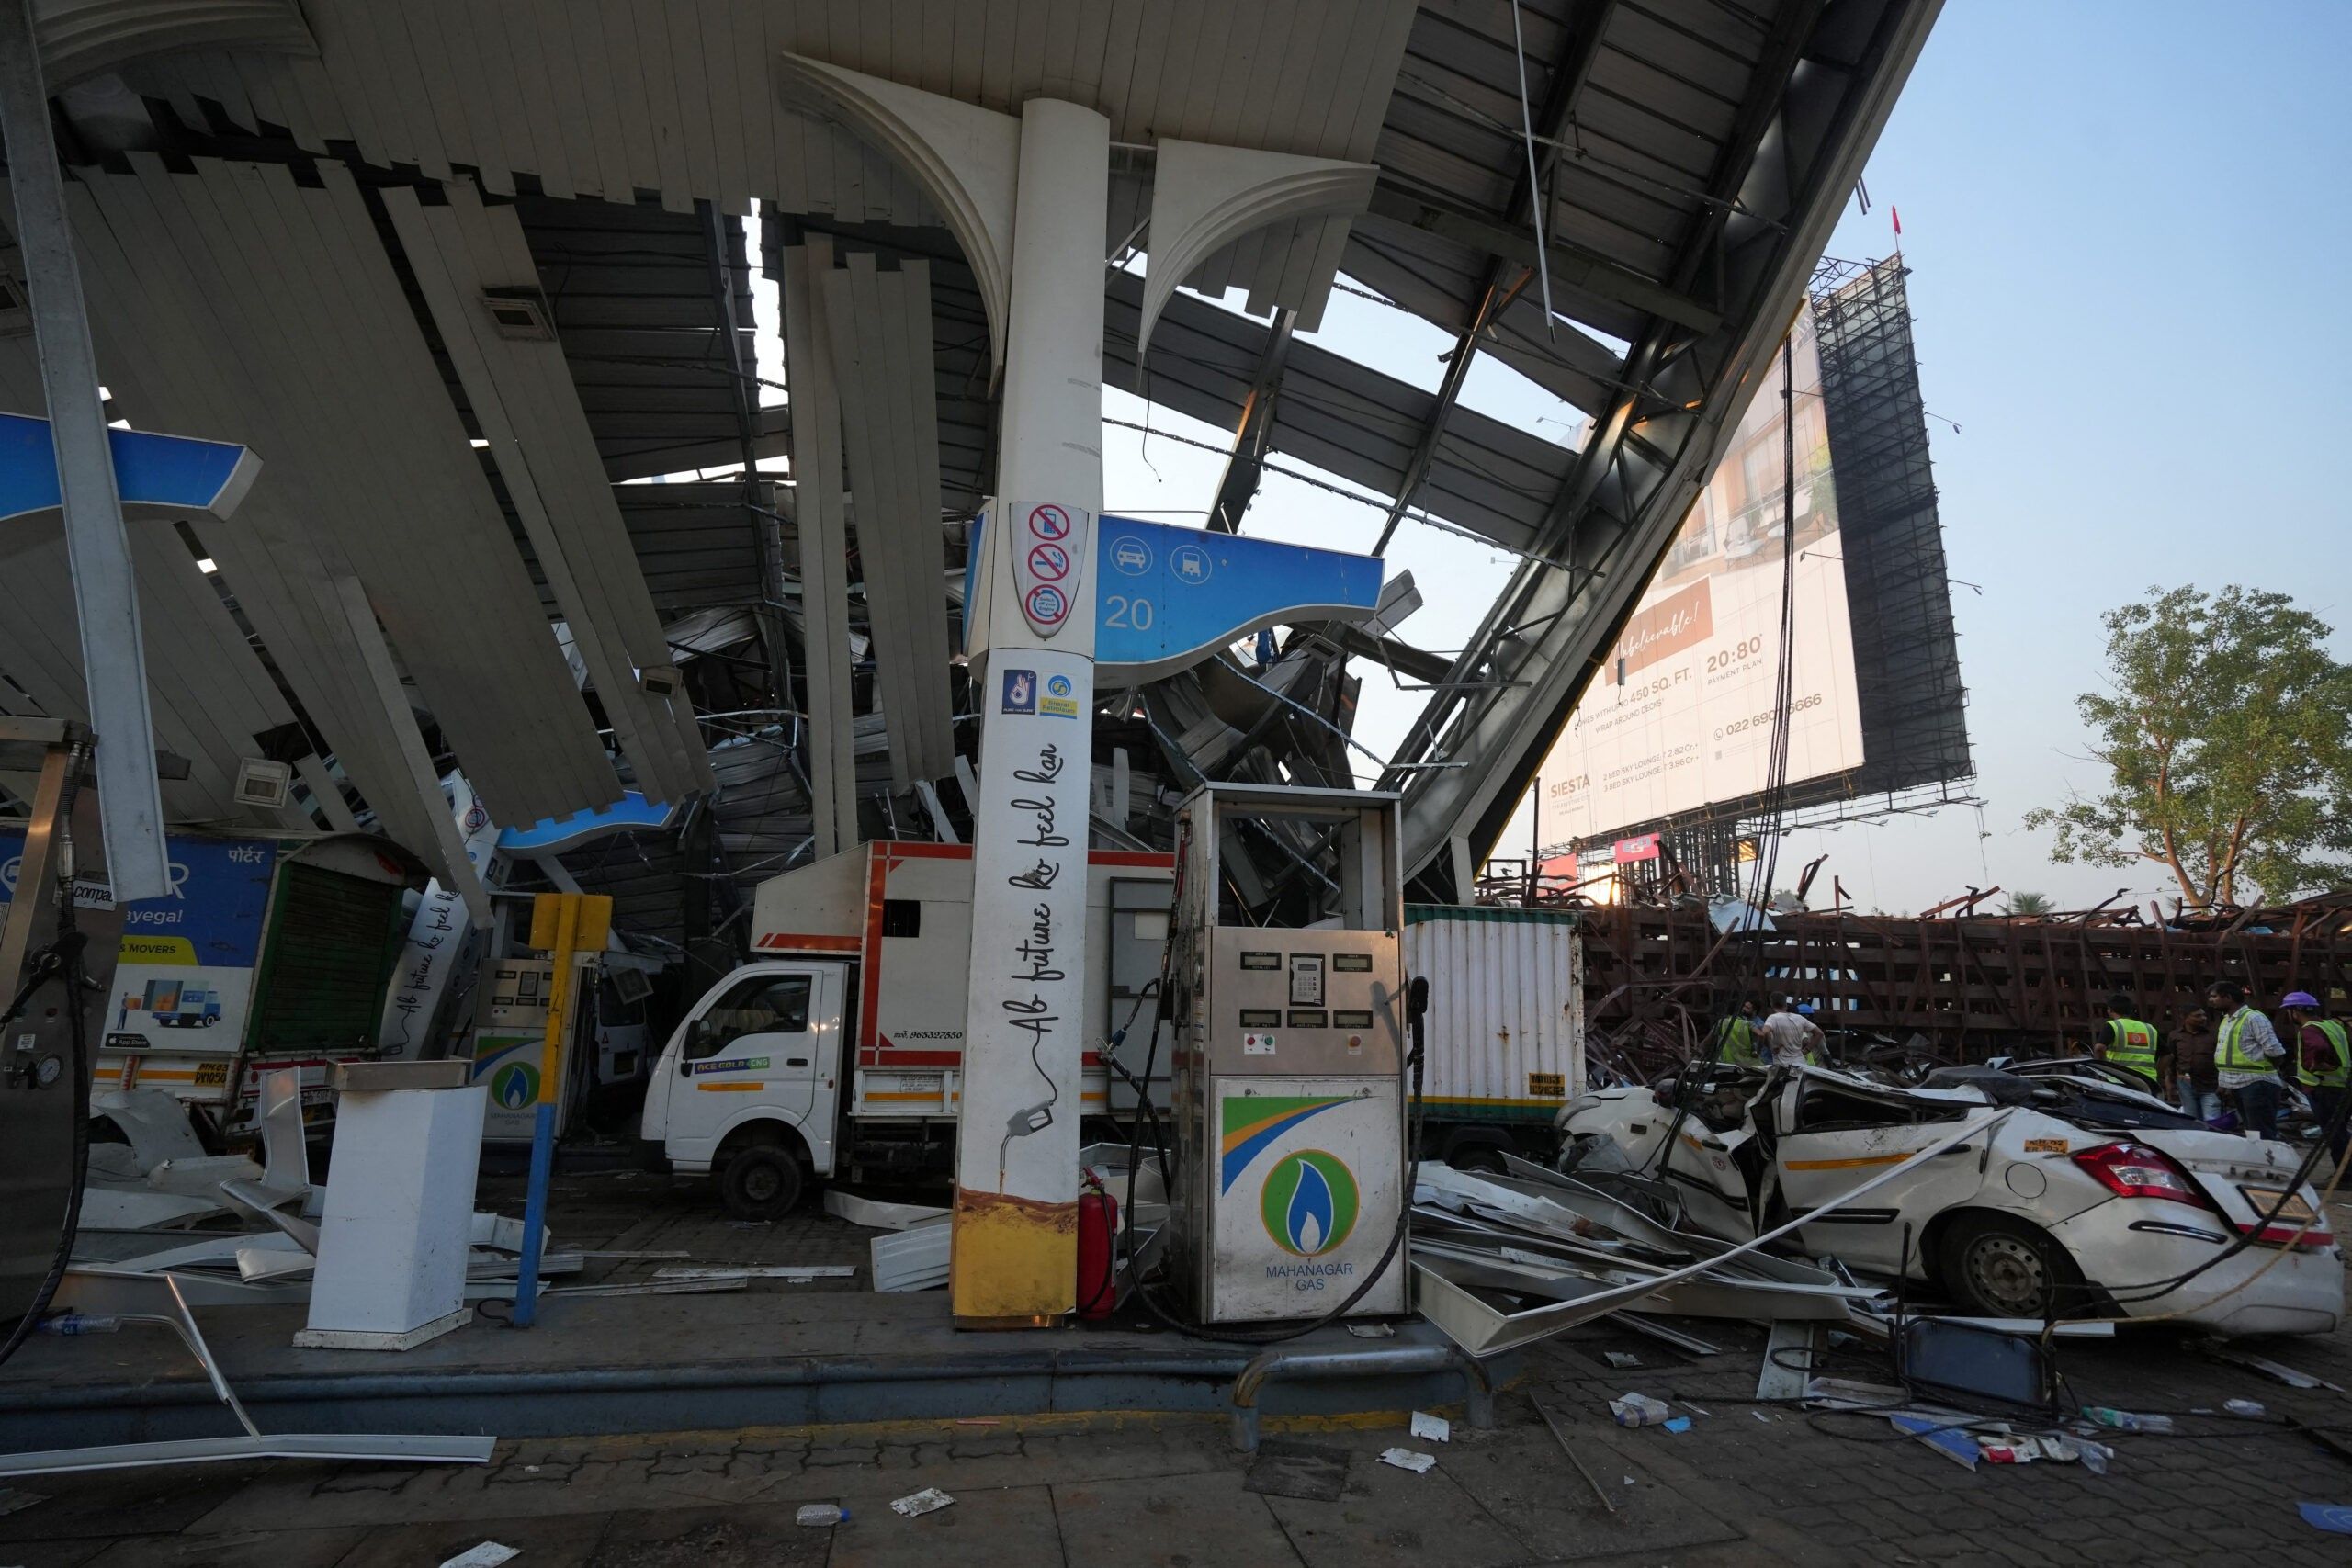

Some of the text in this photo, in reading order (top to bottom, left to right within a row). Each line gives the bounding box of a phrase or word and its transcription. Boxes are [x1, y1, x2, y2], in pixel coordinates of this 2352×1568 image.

[1105, 594, 1153, 631] 20
[1707, 659, 1763, 685] PAYMENT PLAN
[1630, 686, 1650, 704] 450
[1652, 678, 1672, 694] SQ.
[1675, 668, 1692, 685] FT.
[1595, 720, 1613, 734] WRAP
[1614, 709, 1640, 727] AROUND
[1726, 719, 1749, 735] 022
[1013, 743, 1064, 784] kar
[1551, 773, 1590, 798] SIESTA
[1011, 796, 1069, 846] feel
[228, 846, 266, 867] पोर्टर
[129, 944, 176, 954] MOVERS
[1012, 903, 1066, 981] future
[751, 1058, 768, 1066] CNG
[1266, 1263, 1353, 1278] MAHANAGAR
[1295, 1278, 1325, 1291] GAS
